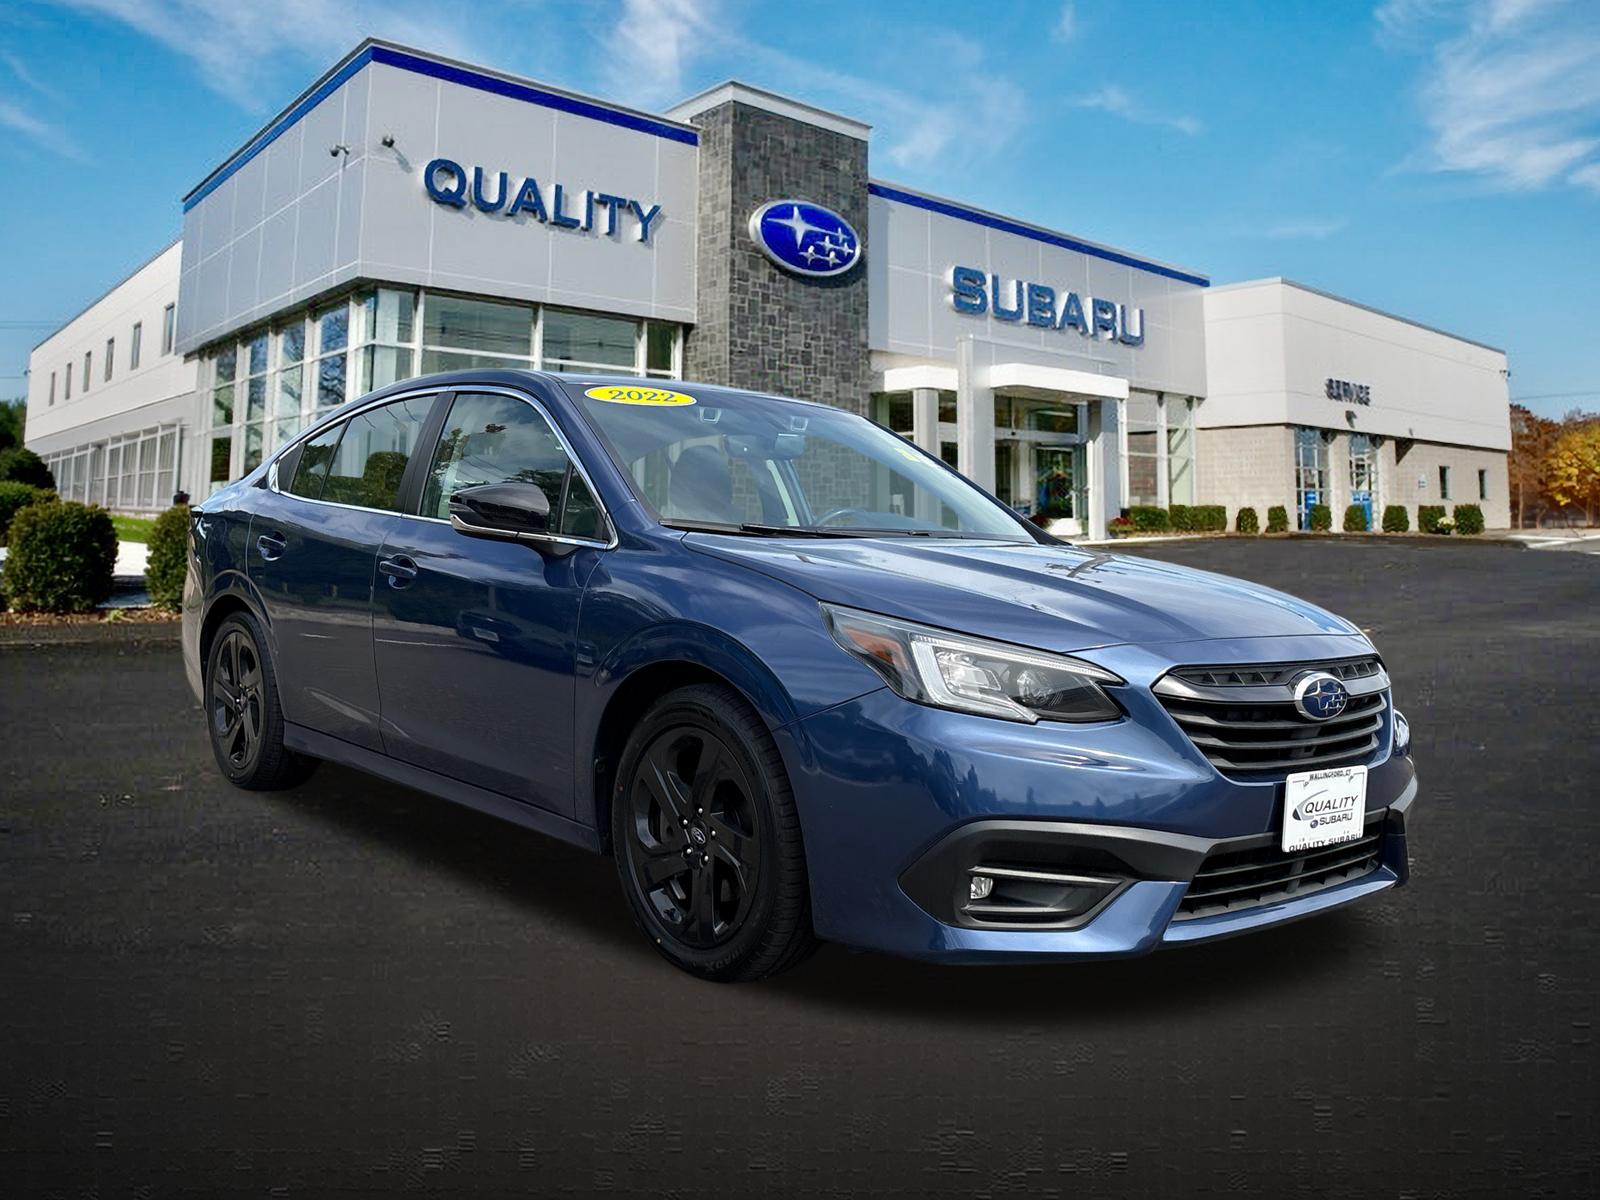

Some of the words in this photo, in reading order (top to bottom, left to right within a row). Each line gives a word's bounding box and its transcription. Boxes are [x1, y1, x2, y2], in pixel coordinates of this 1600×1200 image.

[424, 157, 662, 243] QUALITY
[950, 265, 1145, 346] SUBARU
[609, 390, 678, 403] 2022
[1305, 795, 1359, 814] QUALITY
[1319, 812, 1353, 826] SUBARU
[1289, 839, 1326, 853] QUALITY
[1328, 833, 1362, 845] SUBARU
